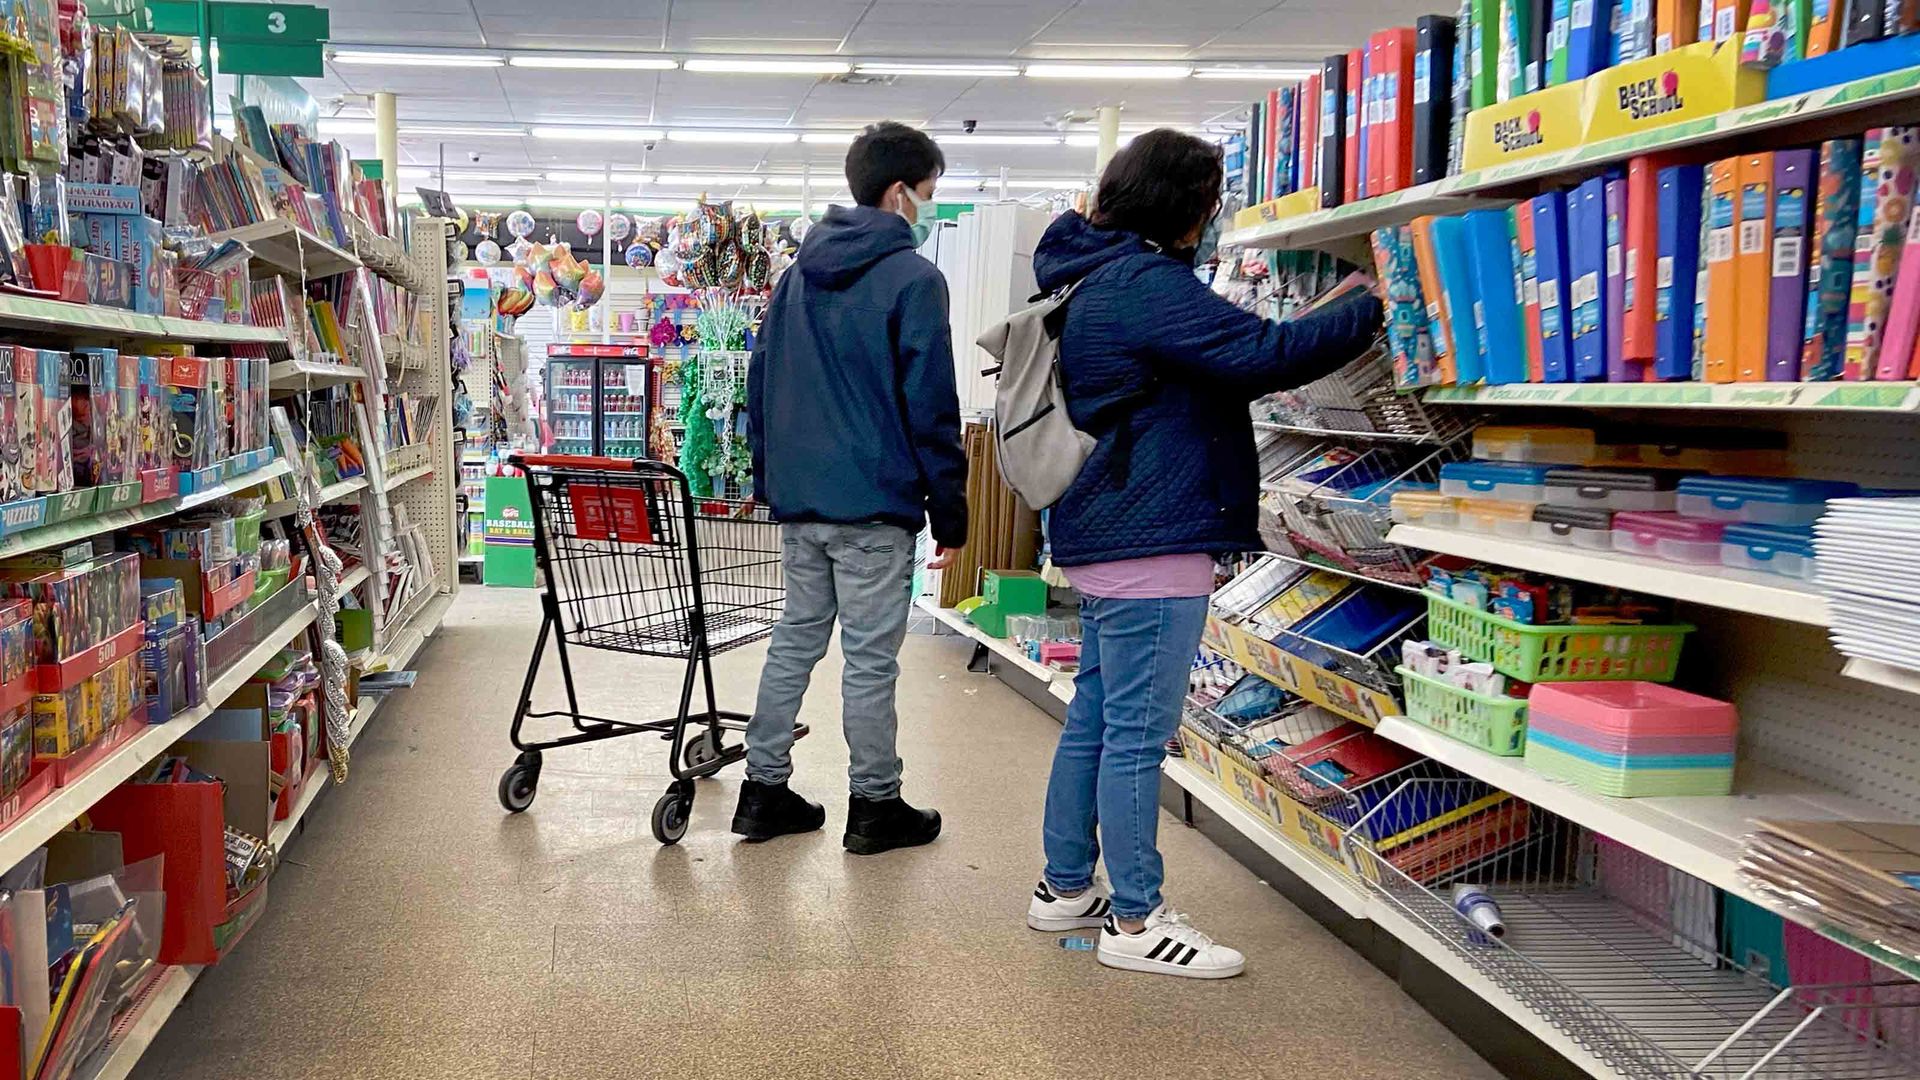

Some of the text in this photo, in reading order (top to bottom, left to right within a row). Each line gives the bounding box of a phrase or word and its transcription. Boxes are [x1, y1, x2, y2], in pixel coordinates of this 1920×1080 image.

[267, 11, 287, 34] 3
[1619, 77, 1657, 110] BACK
[1631, 97, 1684, 120] SCHOOL
[1495, 116, 1522, 144] BACK
[1503, 134, 1543, 152] SCHOOL
[62, 492, 82, 511] 24
[112, 485, 131, 502] 48
[2, 503, 40, 526] PUZZLES
[486, 519, 535, 529] BASEBALL
[98, 641, 117, 664] 500
